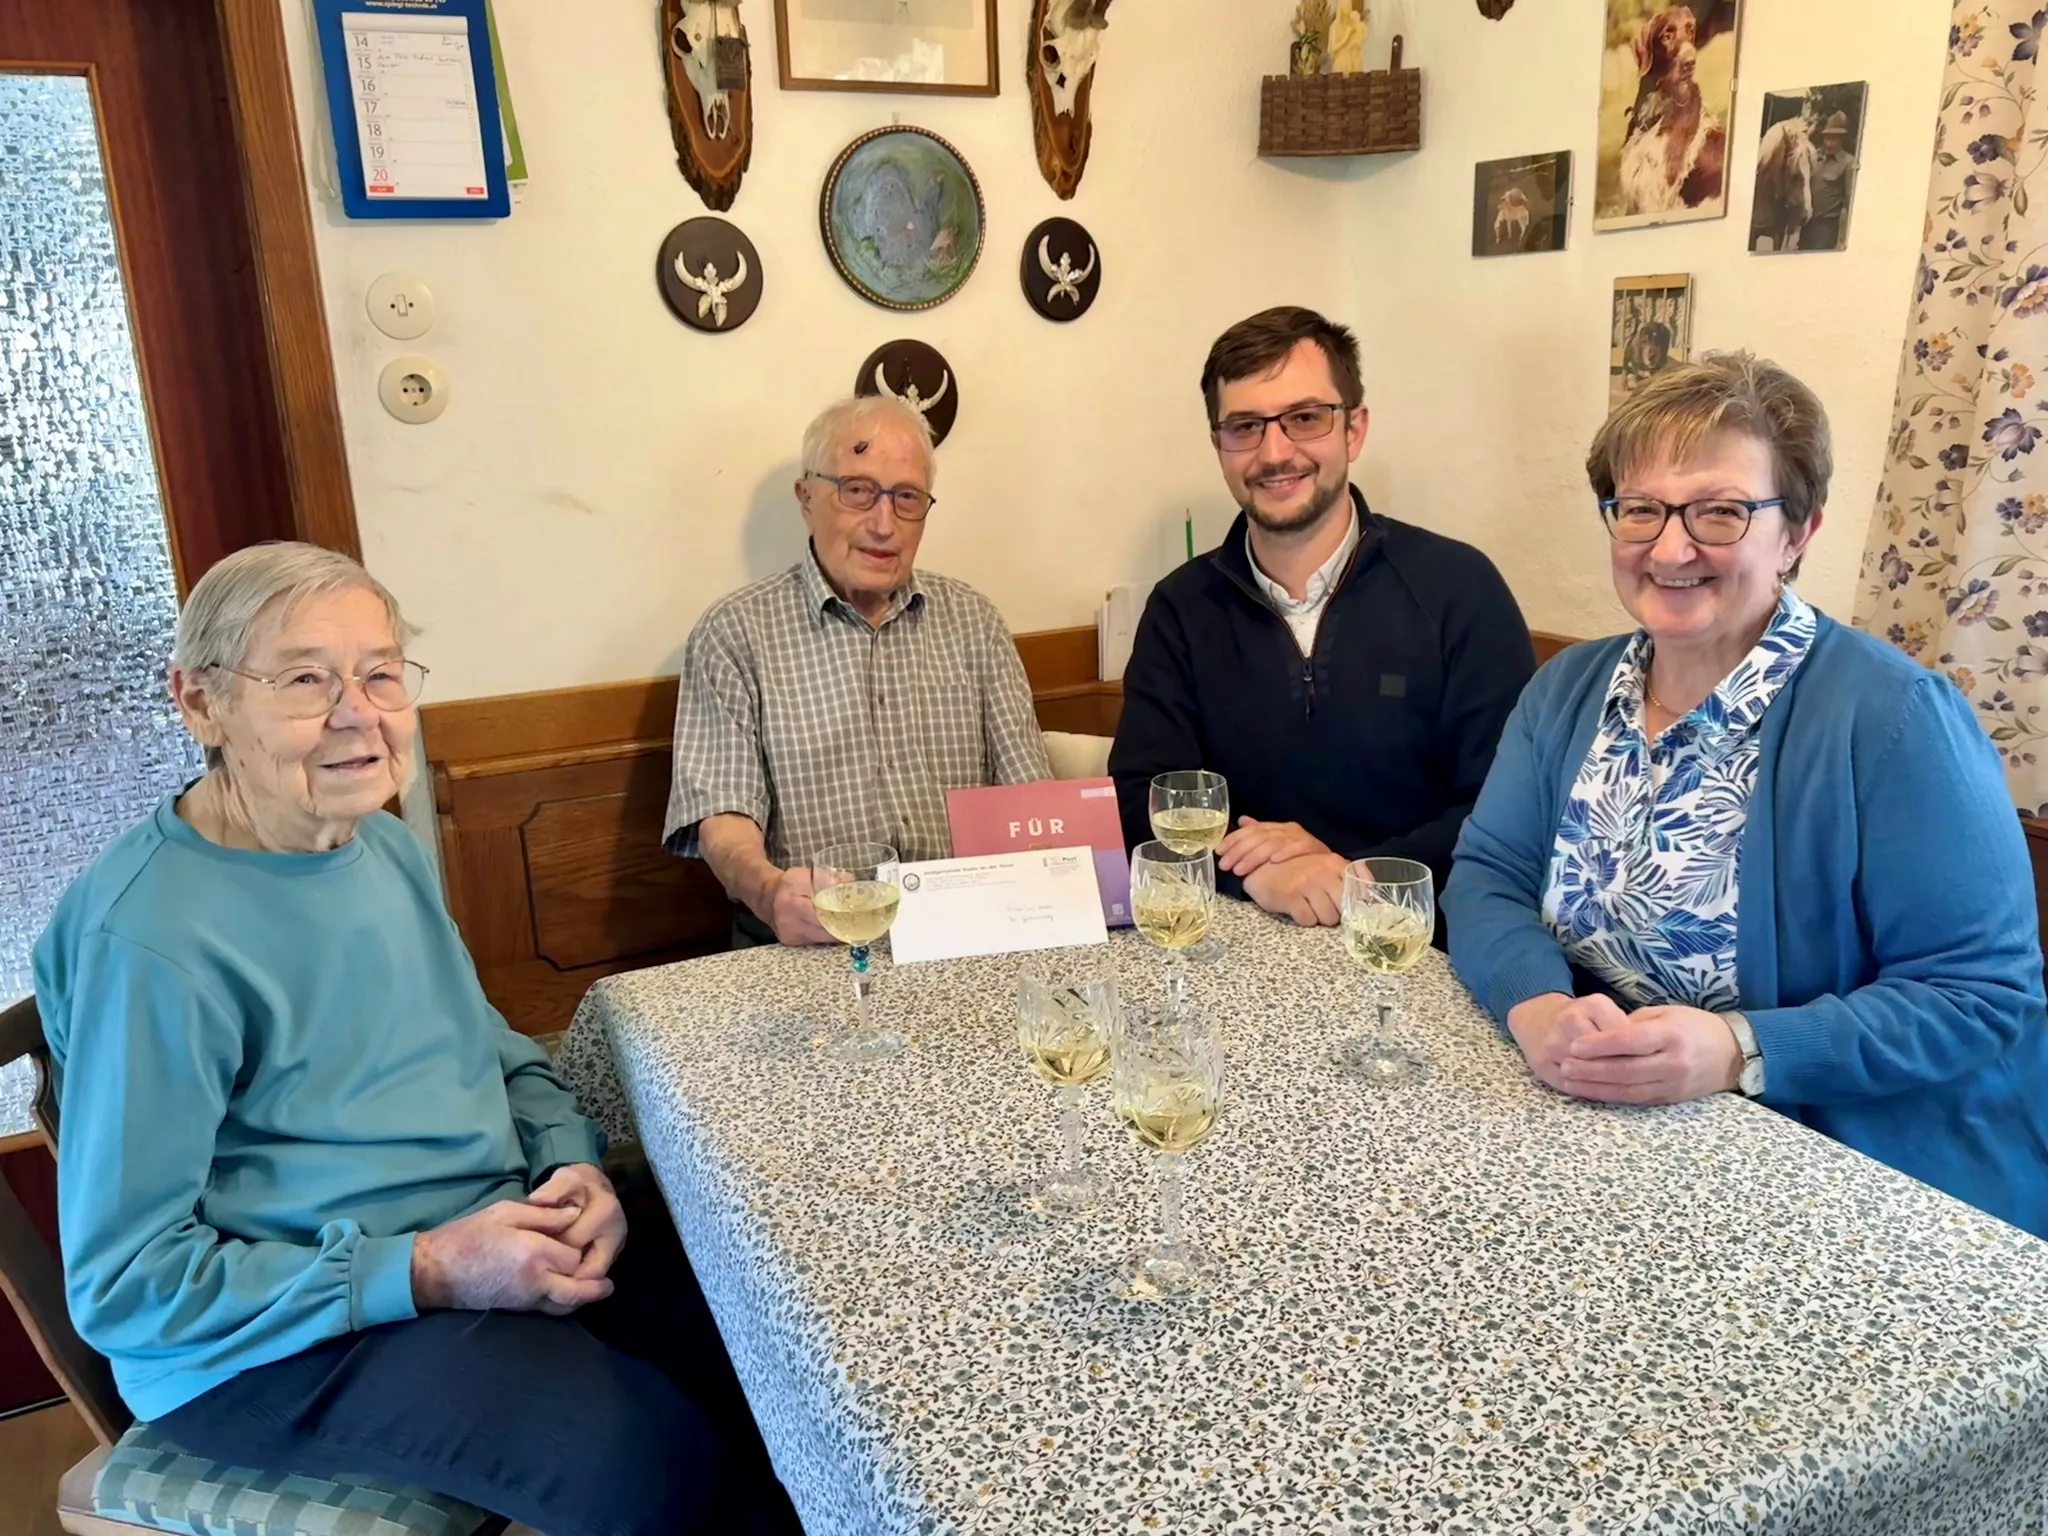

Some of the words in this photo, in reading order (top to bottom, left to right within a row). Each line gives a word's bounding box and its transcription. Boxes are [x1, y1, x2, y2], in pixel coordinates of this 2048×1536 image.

[354, 35, 369, 48] 14
[357, 56, 372, 70] 15
[360, 78, 376, 92] 16
[364, 101, 378, 114] 17
[366, 123, 382, 137] 18
[370, 145, 385, 159] 19
[372, 168, 388, 182] 20
[1008, 817, 1065, 839] FÜR
